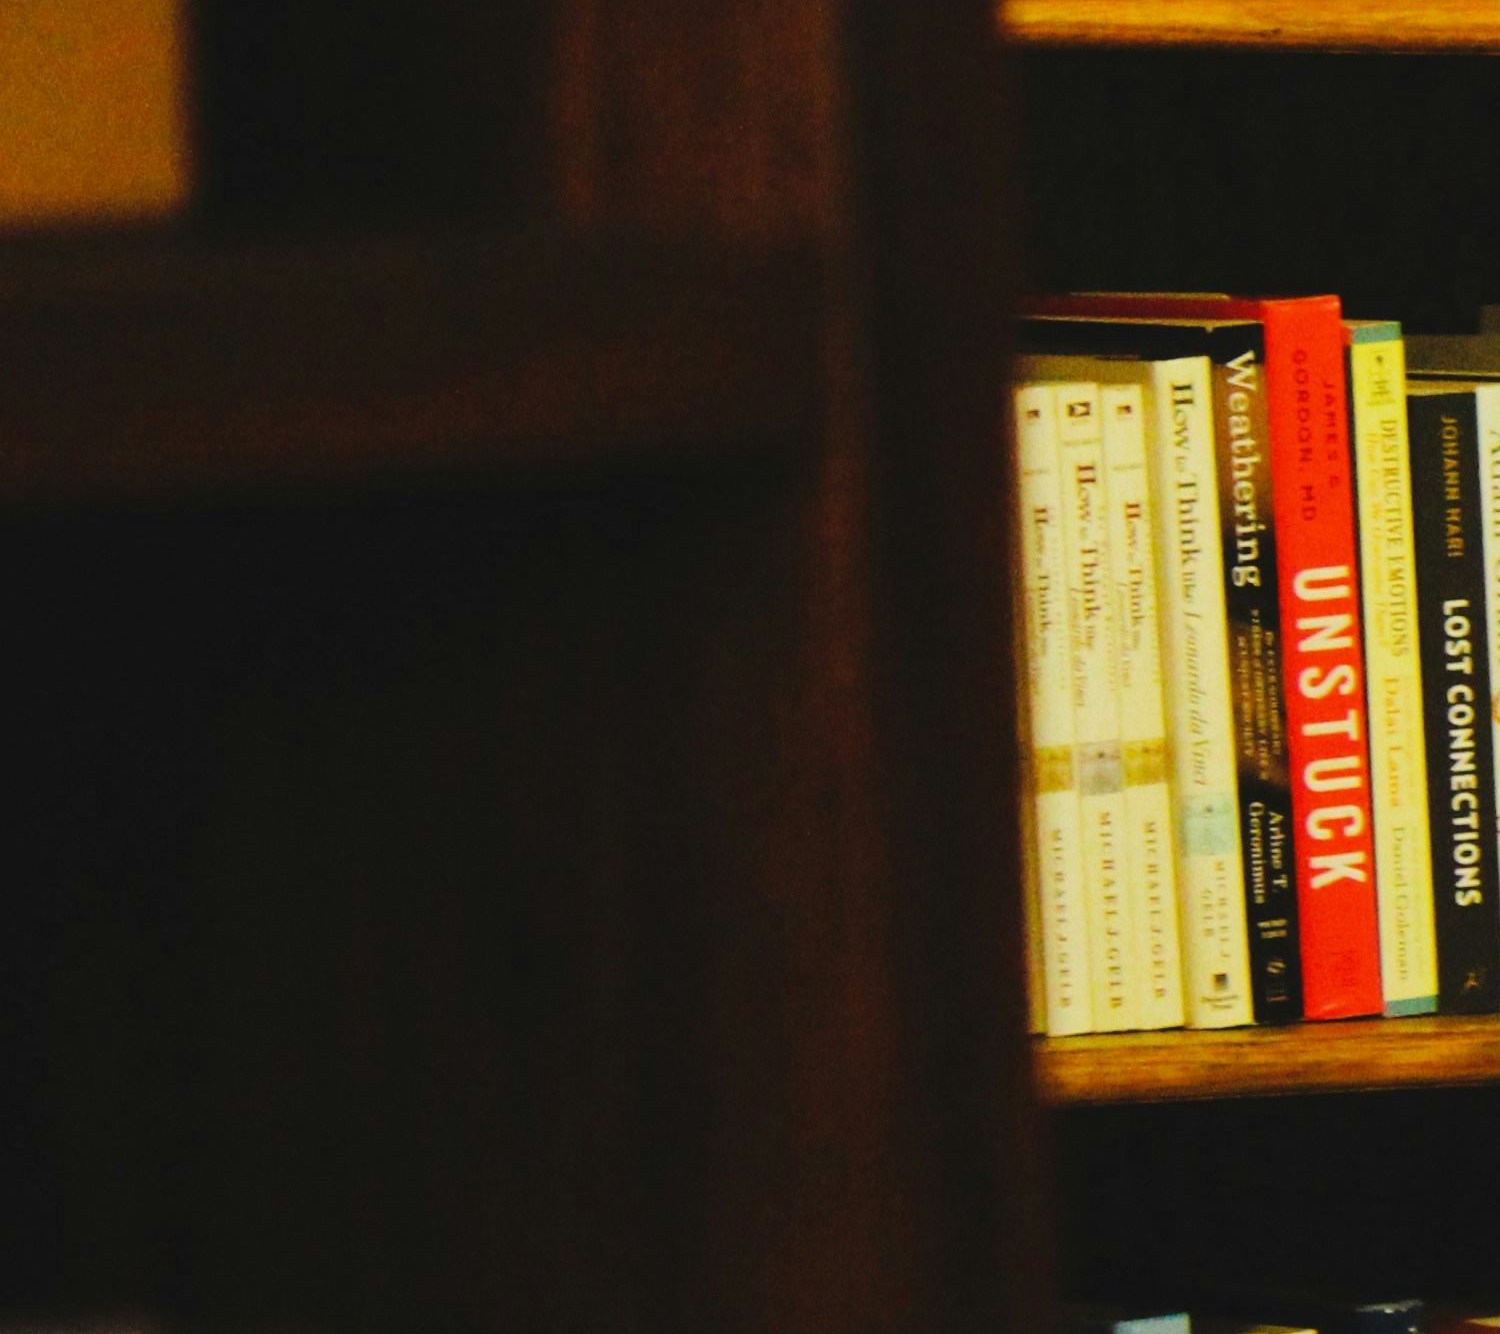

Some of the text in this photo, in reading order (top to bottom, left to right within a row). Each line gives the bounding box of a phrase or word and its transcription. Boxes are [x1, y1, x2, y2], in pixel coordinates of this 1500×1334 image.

[1223, 351, 1265, 590] Weathering
[1291, 564, 1366, 891] UNSTUCK
[1439, 417, 1481, 908] JOHANN HARI LOST CONNECTIONS
[1247, 801, 1271, 906] Geronimus
[1265, 809, 1287, 868] Arline
